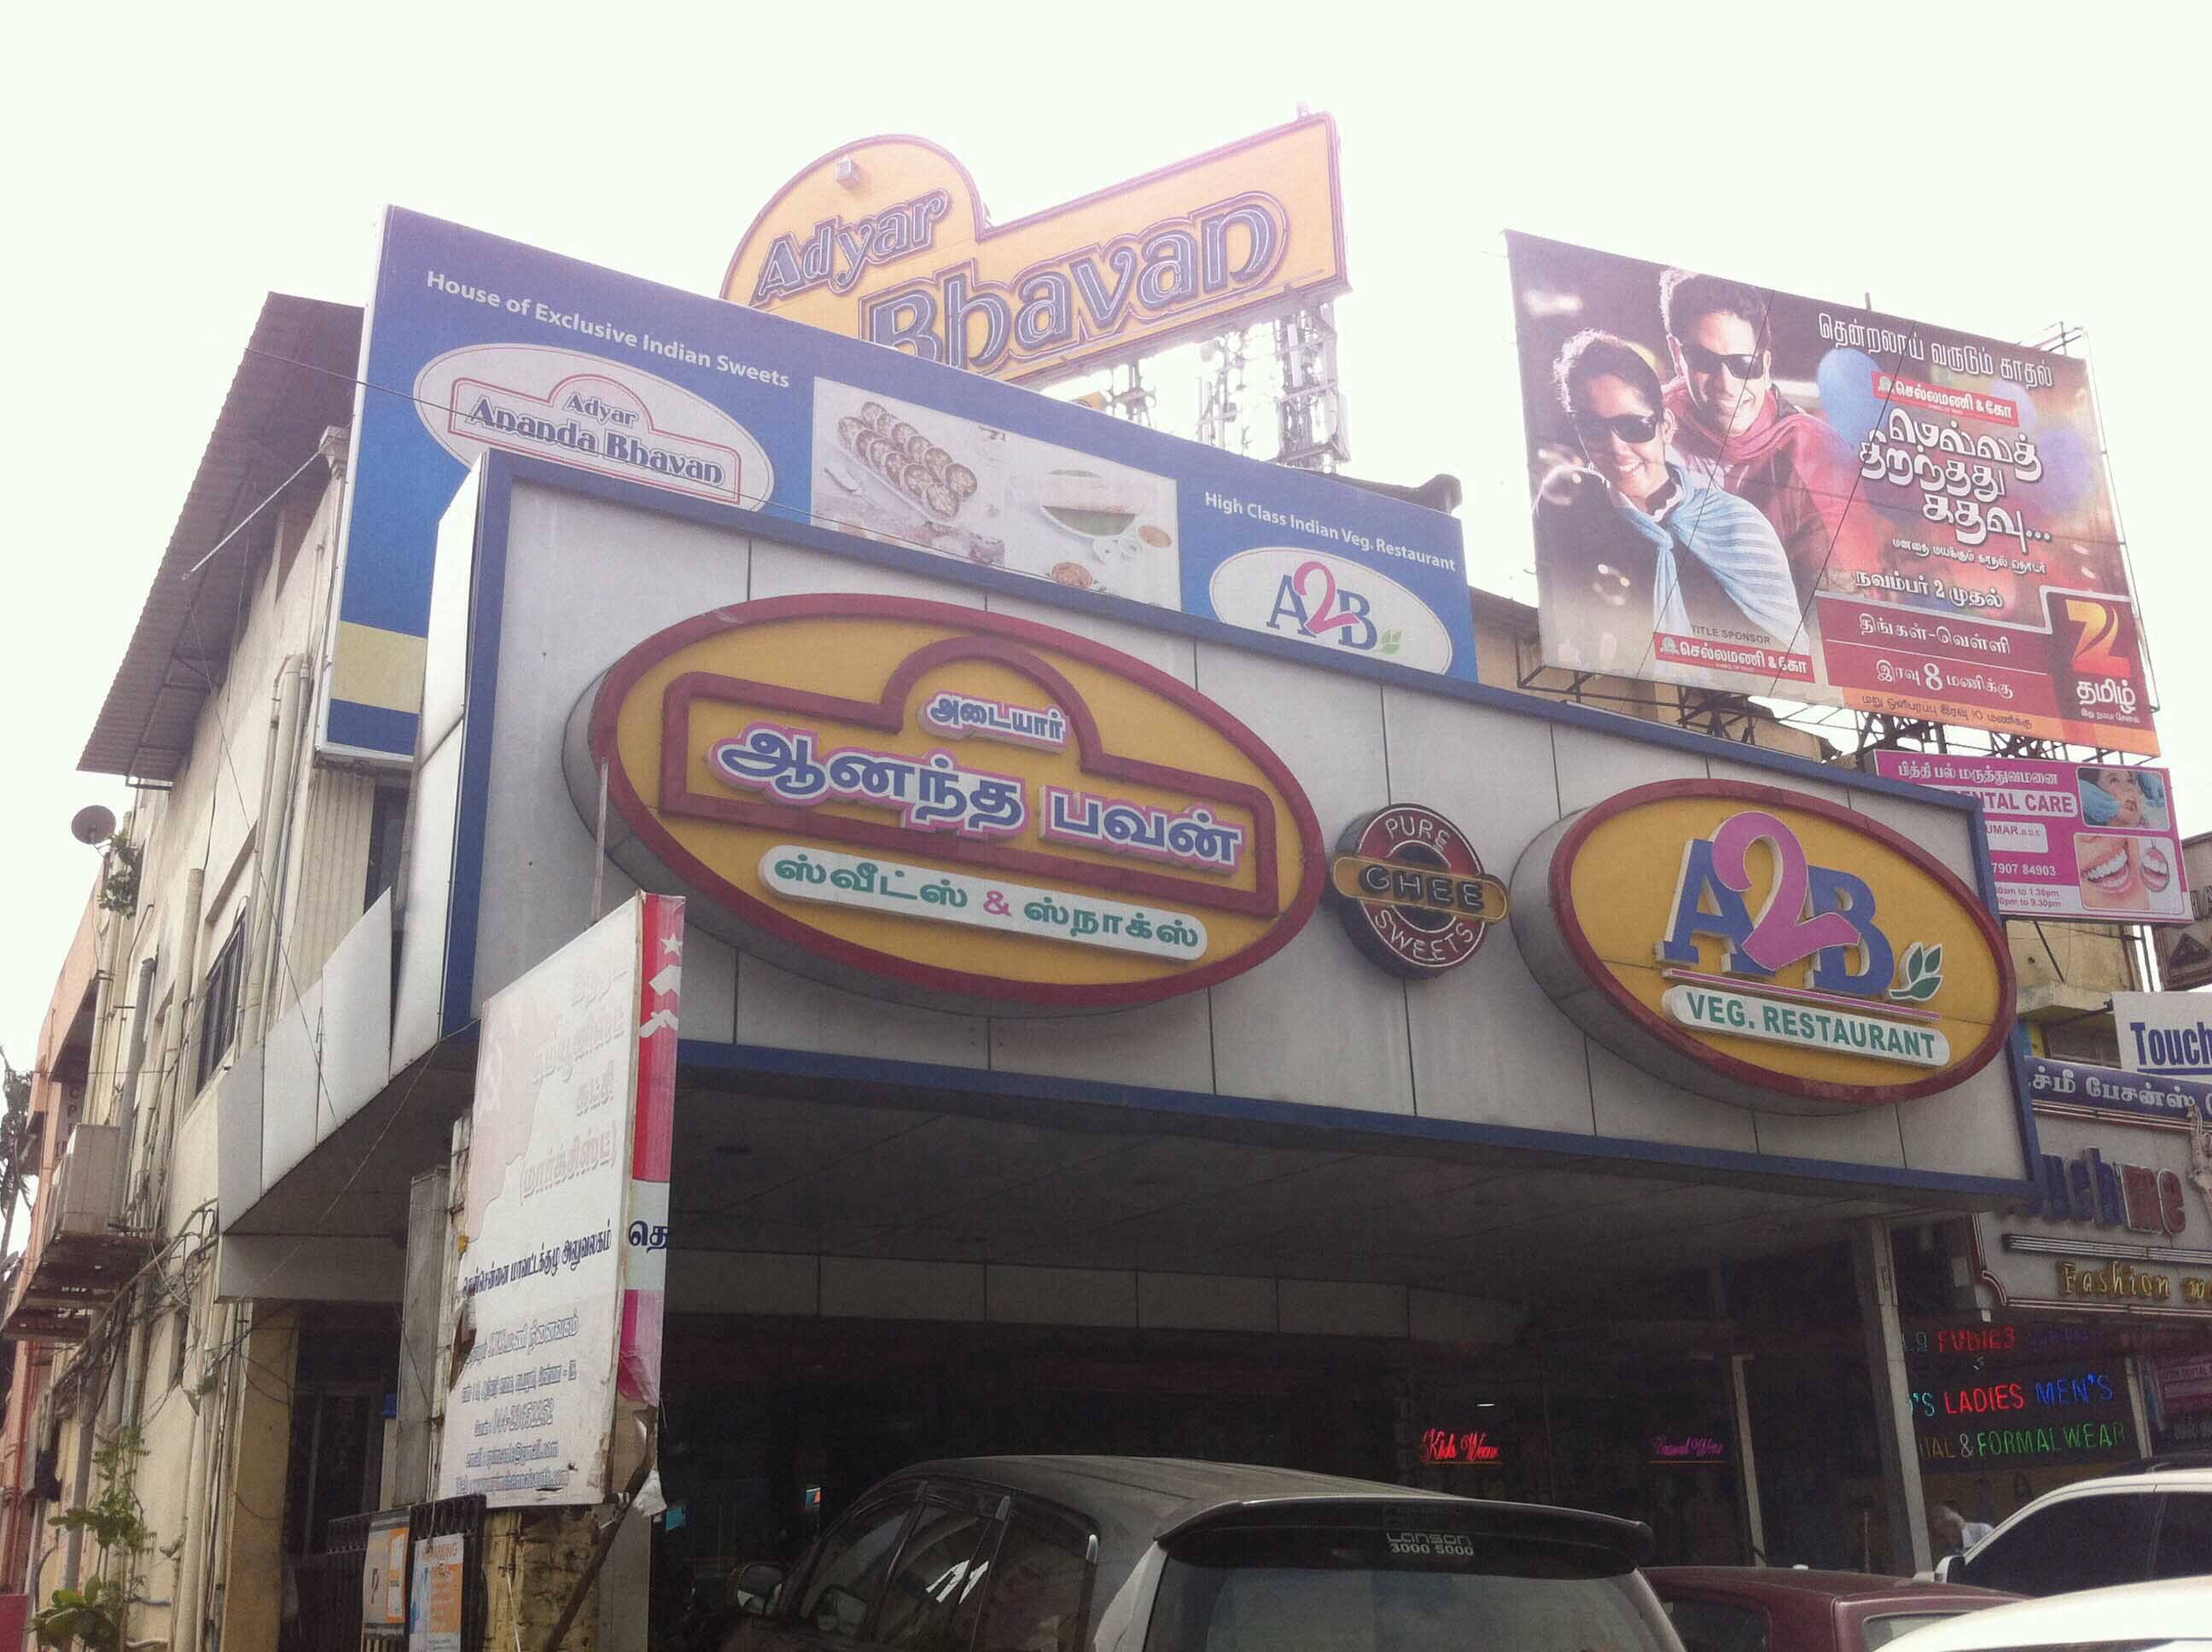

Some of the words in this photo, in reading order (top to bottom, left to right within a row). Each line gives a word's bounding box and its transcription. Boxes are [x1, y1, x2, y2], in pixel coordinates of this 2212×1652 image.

[758, 189, 947, 297] Adyar
[862, 193, 1285, 369] Bhavan
[427, 271, 500, 307] House
[505, 295, 532, 316] of
[534, 303, 638, 347] Exclusive
[643, 334, 711, 369] Indian
[716, 354, 791, 389] Sweets
[1818, 312, 1924, 362] தென்றலாய்
[1930, 341, 1994, 375] வருடும்
[2000, 358, 2054, 389] காதல்
[564, 392, 638, 427] Adyar
[1985, 399, 2012, 419] கோ
[468, 396, 599, 456] Ananda
[604, 429, 725, 486] Bhavan
[1859, 428, 2006, 502] திறந்தது
[1888, 408, 2042, 482] மெல்லத்
[1205, 492, 1243, 515] High
[1247, 503, 1287, 526] Class
[1289, 515, 1339, 540] Indian
[1341, 527, 1375, 552] Veg.
[1376, 538, 1457, 573] Restaurant
[1266, 561, 1378, 650] A2B
[1855, 570, 1929, 596] நவம்பர்
[1934, 579, 1946, 598] 2
[1949, 587, 2004, 608] முதல்
[1679, 640, 1765, 668] செல்லமணி
[1778, 655, 1807, 674] கோ
[1692, 625, 1719, 637] TITLE
[1720, 629, 1771, 645] SPONSOR
[1876, 660, 1920, 685] இரவு
[1923, 663, 1943, 691] 8
[1947, 674, 2014, 700] மணிக்கு
[2076, 678, 2136, 714] தமிழ்
[928, 694, 1065, 744] அடையார்
[718, 726, 1022, 831] ஆனந்த
[1046, 792, 1243, 869] பவன்
[1935, 762, 1956, 779] பல்
[1959, 765, 2058, 786] மருத்துவமனை
[2024, 794, 2075, 814] CARE
[1385, 815, 1451, 854] PURE
[773, 853, 967, 910] ஸ்வீட்ஸ்
[983, 887, 1013, 917] &
[1024, 898, 1200, 948] ஸ்நாக்ஸ்
[1359, 864, 1485, 912] GHEE
[1656, 810, 1895, 997] A2B
[1375, 909, 1474, 962] SWEETS
[1686, 992, 1755, 1027] VEG.
[1761, 1003, 1936, 1060] RESTAURANT
[2130, 1021, 2212, 1067] Touch
[2061, 1260, 2171, 1298] Fashion
[1943, 1383, 2027, 1415] LADIES
[2034, 1374, 2116, 1405] MEN'S
[1959, 1432, 1974, 1457] &
[1976, 1424, 2063, 1457] FORMAL
[1389, 1542, 1430, 1554] 3000
[1434, 1543, 1475, 1556] 5000
